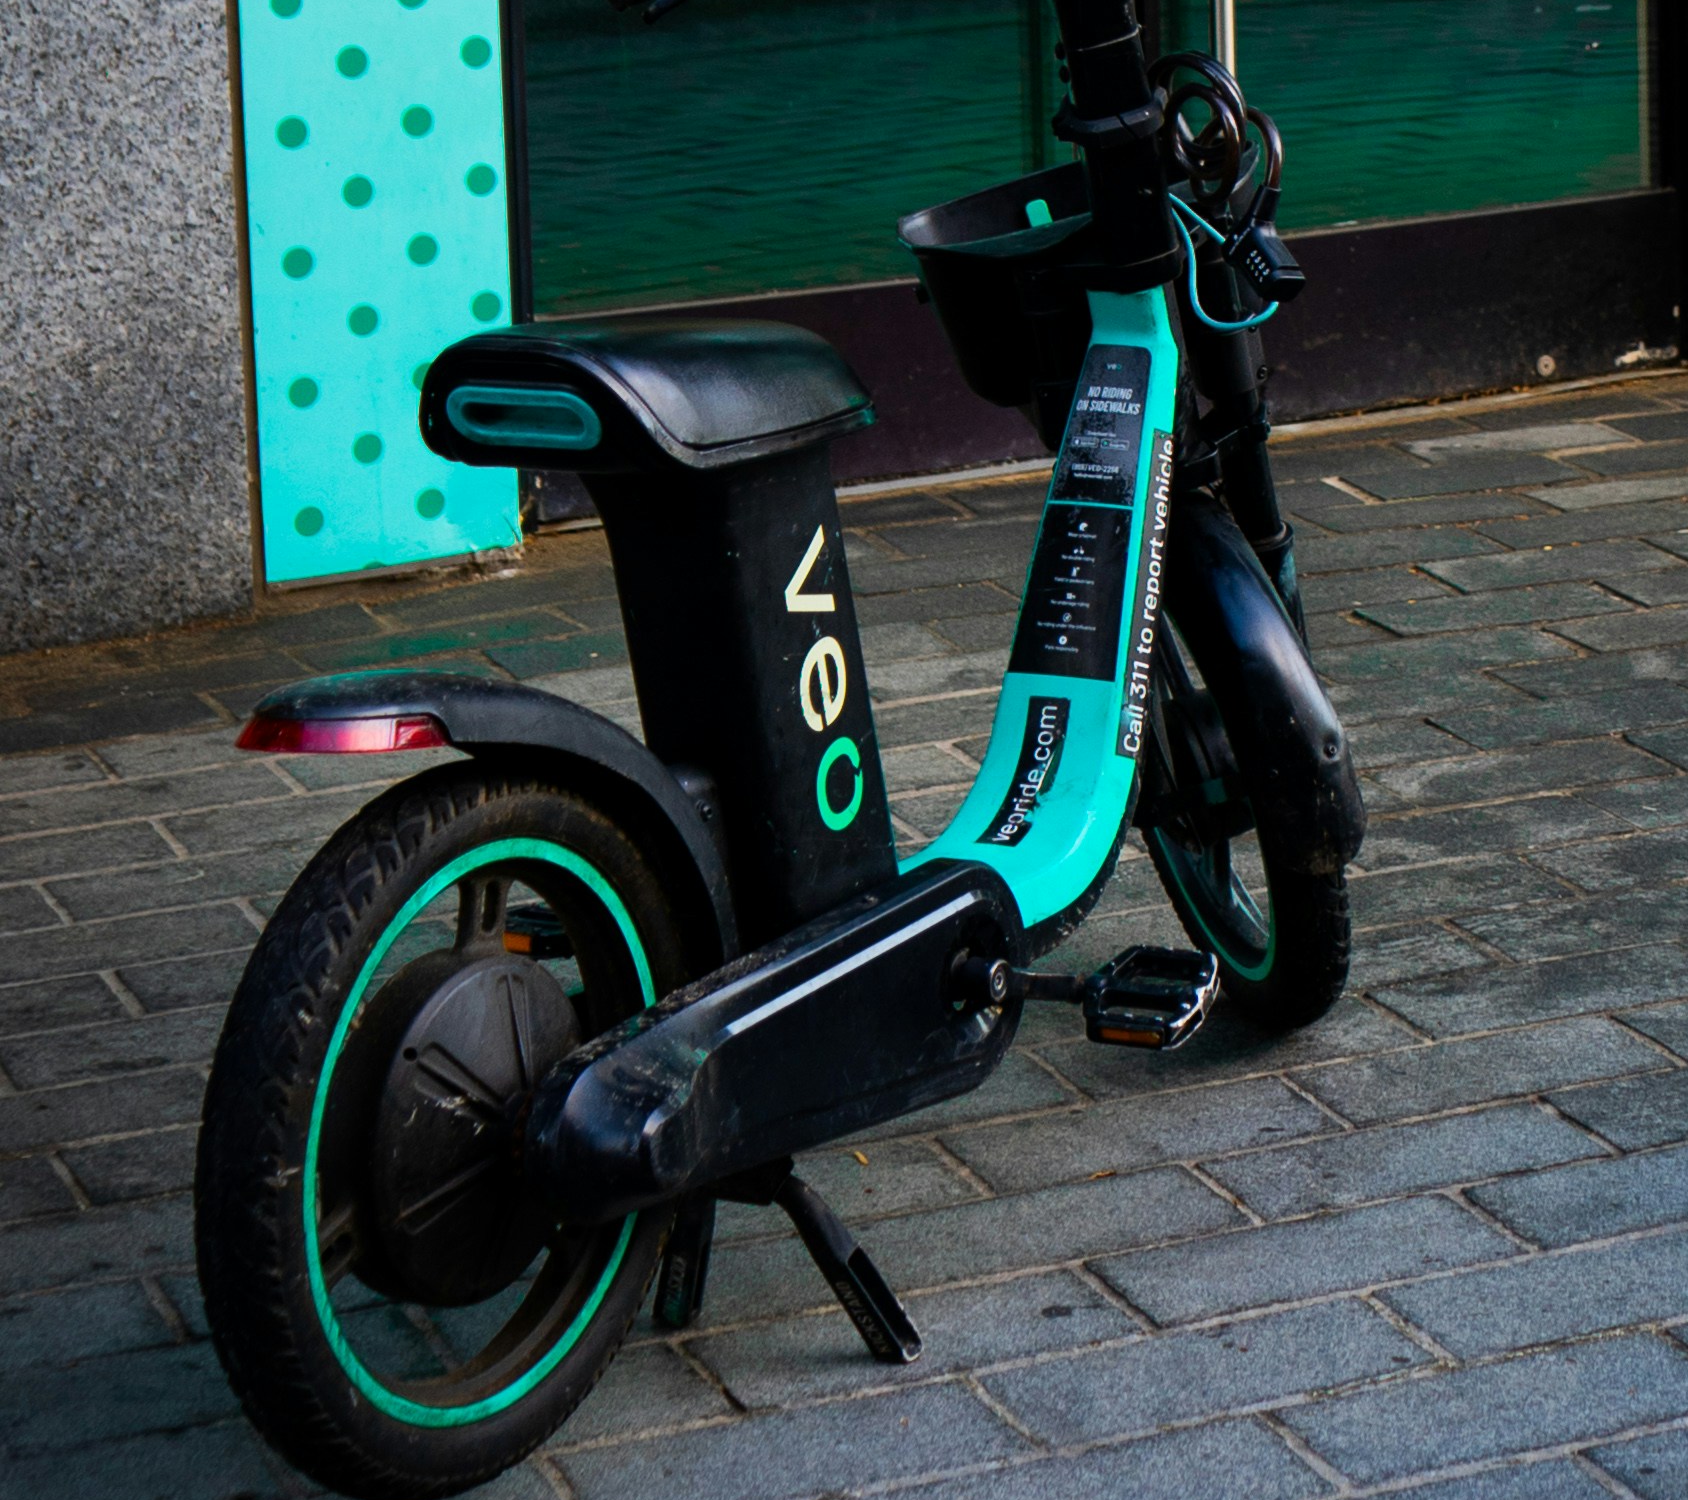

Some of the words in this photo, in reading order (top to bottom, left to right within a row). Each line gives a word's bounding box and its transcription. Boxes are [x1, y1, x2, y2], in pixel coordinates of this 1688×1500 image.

[1076, 399, 1089, 411] ON
[1089, 400, 1141, 415] SIDEWALKS
[1088, 385, 1101, 397] NO
[1102, 387, 1133, 400] RIDING
[1153, 439, 1174, 531] vehicle
[1143, 537, 1164, 622] report
[1136, 627, 1154, 655] to
[785, 525, 865, 833] veo
[1130, 661, 1150, 700] 311
[1123, 704, 1144, 753] Call
[992, 705, 1058, 842] veoride.com
